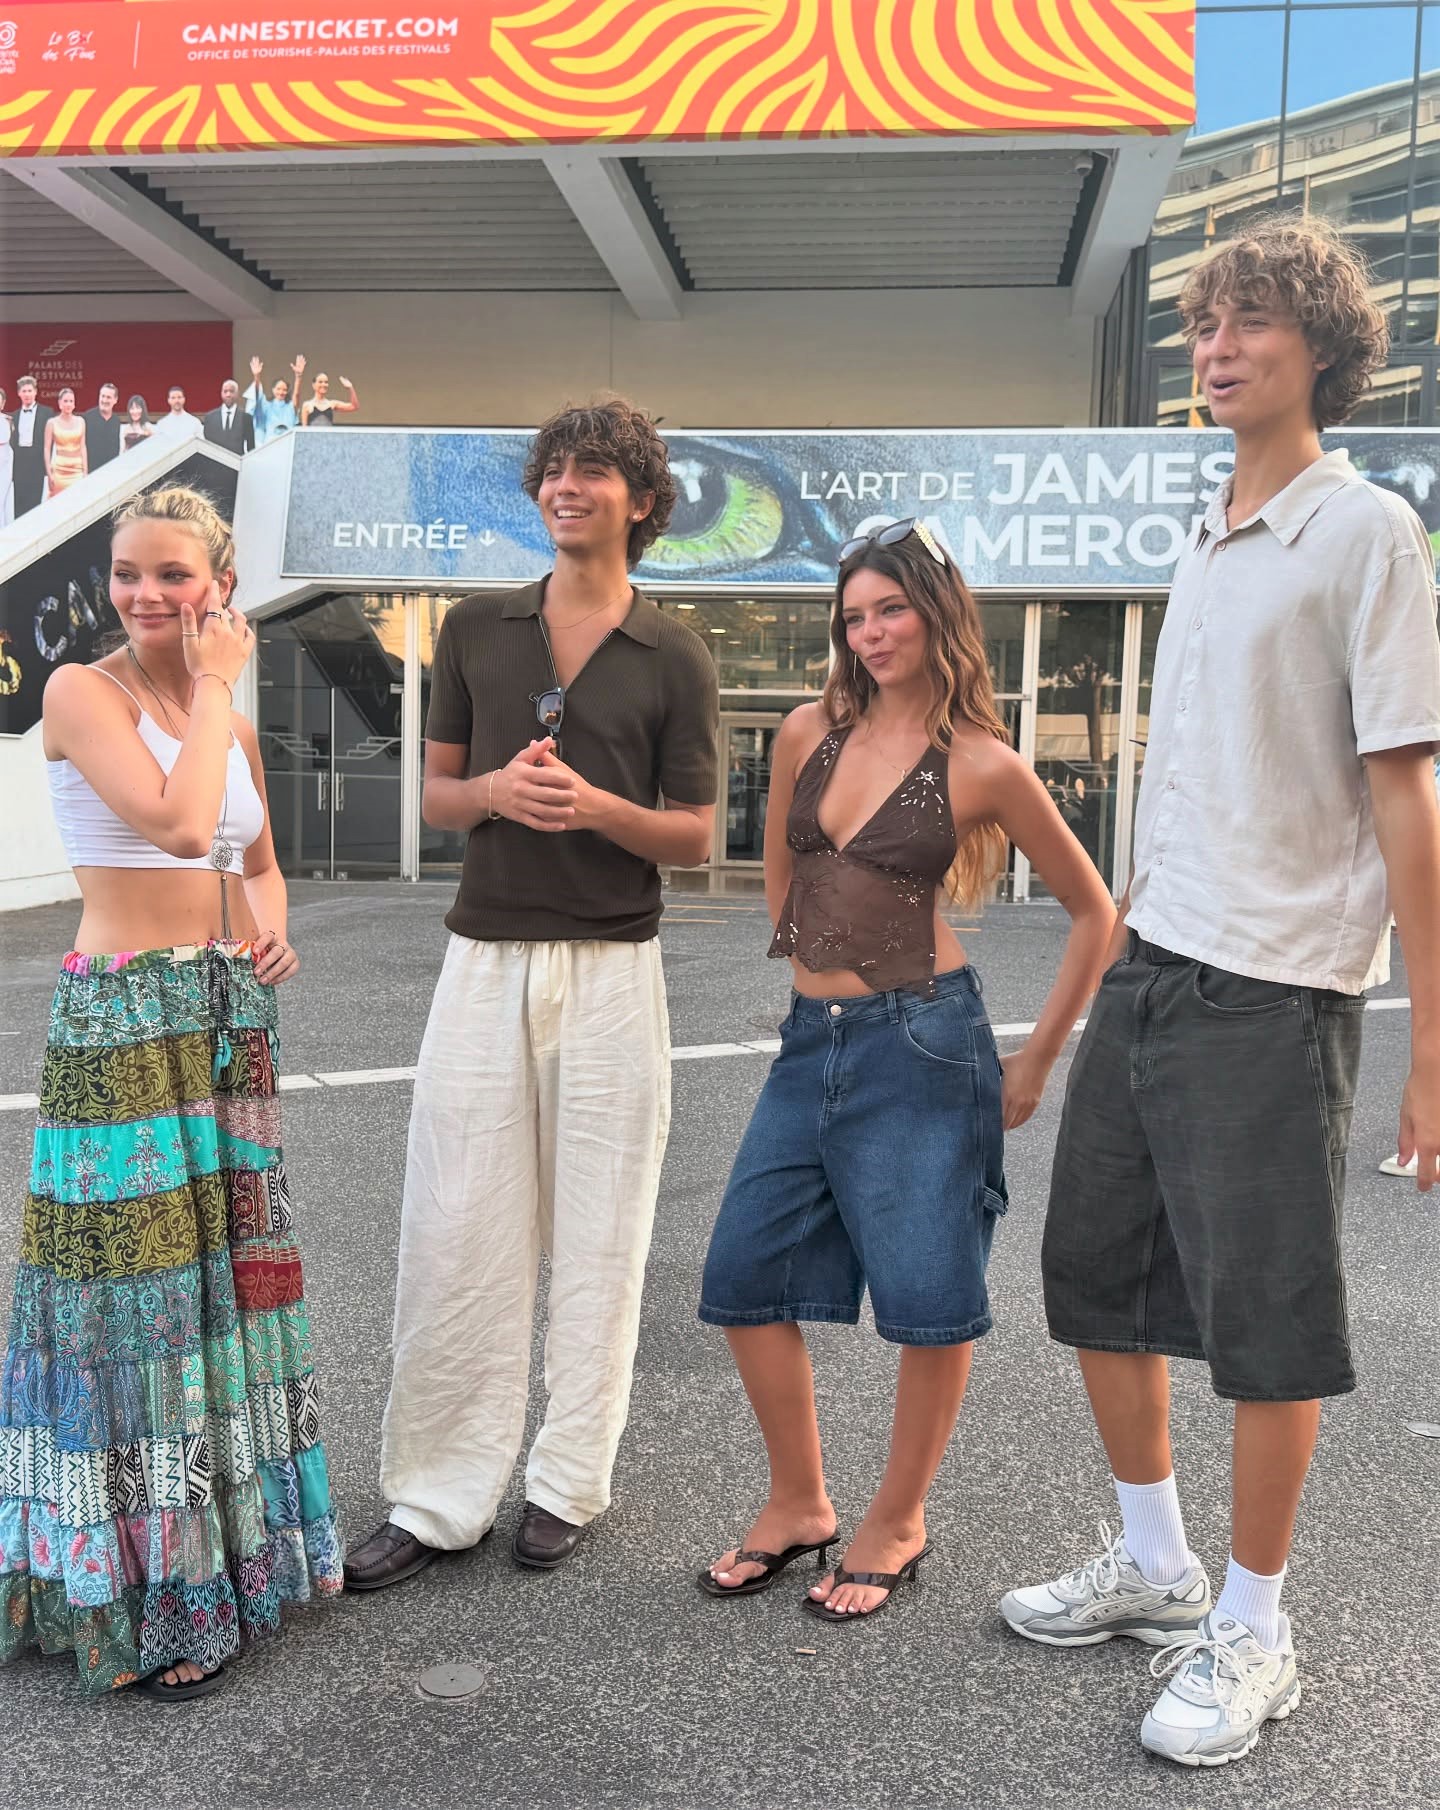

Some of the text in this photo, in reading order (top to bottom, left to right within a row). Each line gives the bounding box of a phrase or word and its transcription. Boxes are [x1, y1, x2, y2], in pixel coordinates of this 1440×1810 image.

[182, 17, 459, 45] CANNESTICKET.COM
[187, 43, 451, 61] OFFICE DE TOURISME-PALAIS DES FESTIVALS
[28, 361, 63, 369] PALAIS
[919, 472, 975, 501] DE
[988, 452, 1235, 505] JAMES
[333, 517, 468, 550] ENTRÉE
[852, 513, 1206, 567] MERO
